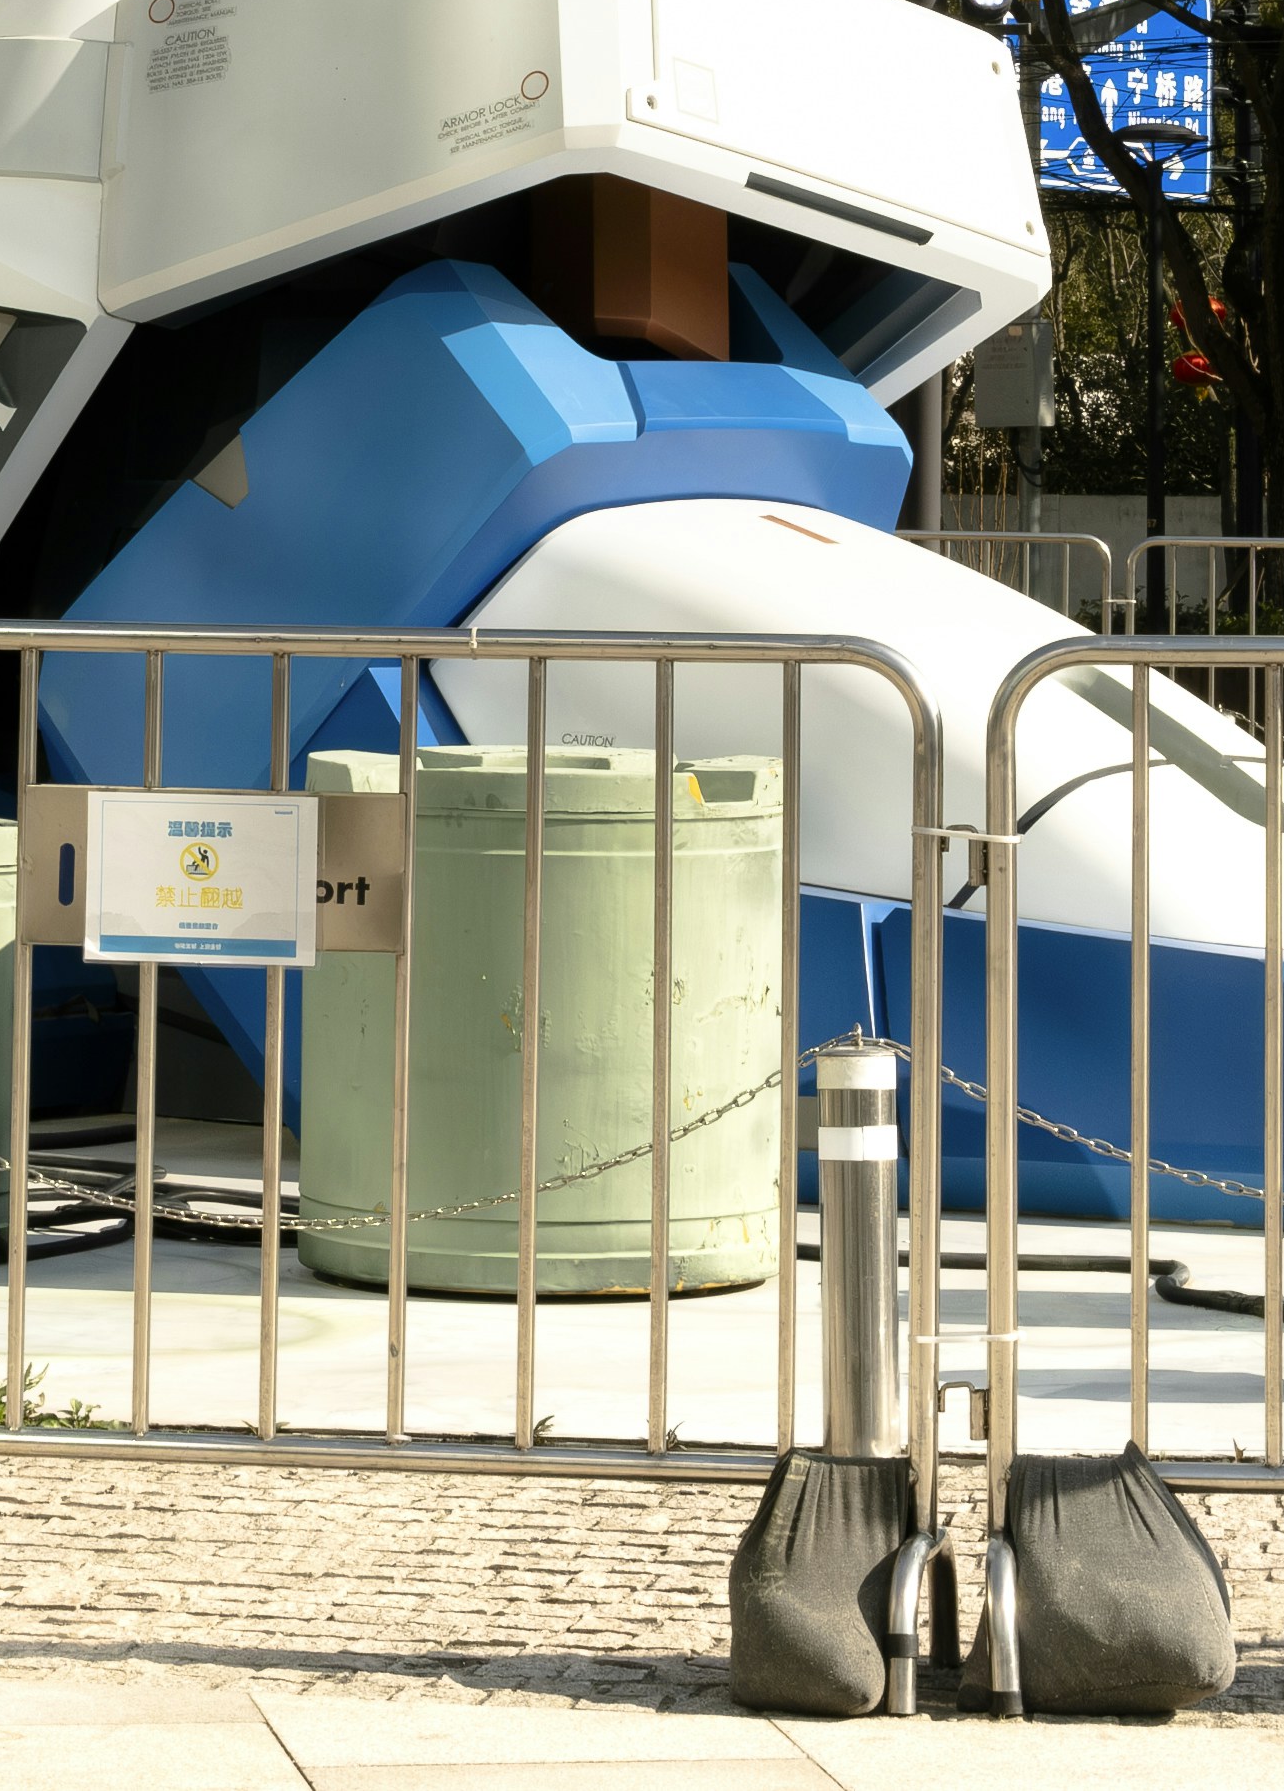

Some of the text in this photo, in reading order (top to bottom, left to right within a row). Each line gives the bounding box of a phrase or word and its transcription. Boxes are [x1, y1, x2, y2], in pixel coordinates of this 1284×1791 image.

[165, 27, 215, 46] CAUTION
[1127, 68, 1203, 111] 宁桥路
[439, 94, 522, 132] ARMOR LOCK
[560, 732, 615, 748] CAUTION
[168, 820, 233, 838] 温馨提示
[155, 885, 243, 910] 禁止翻越
